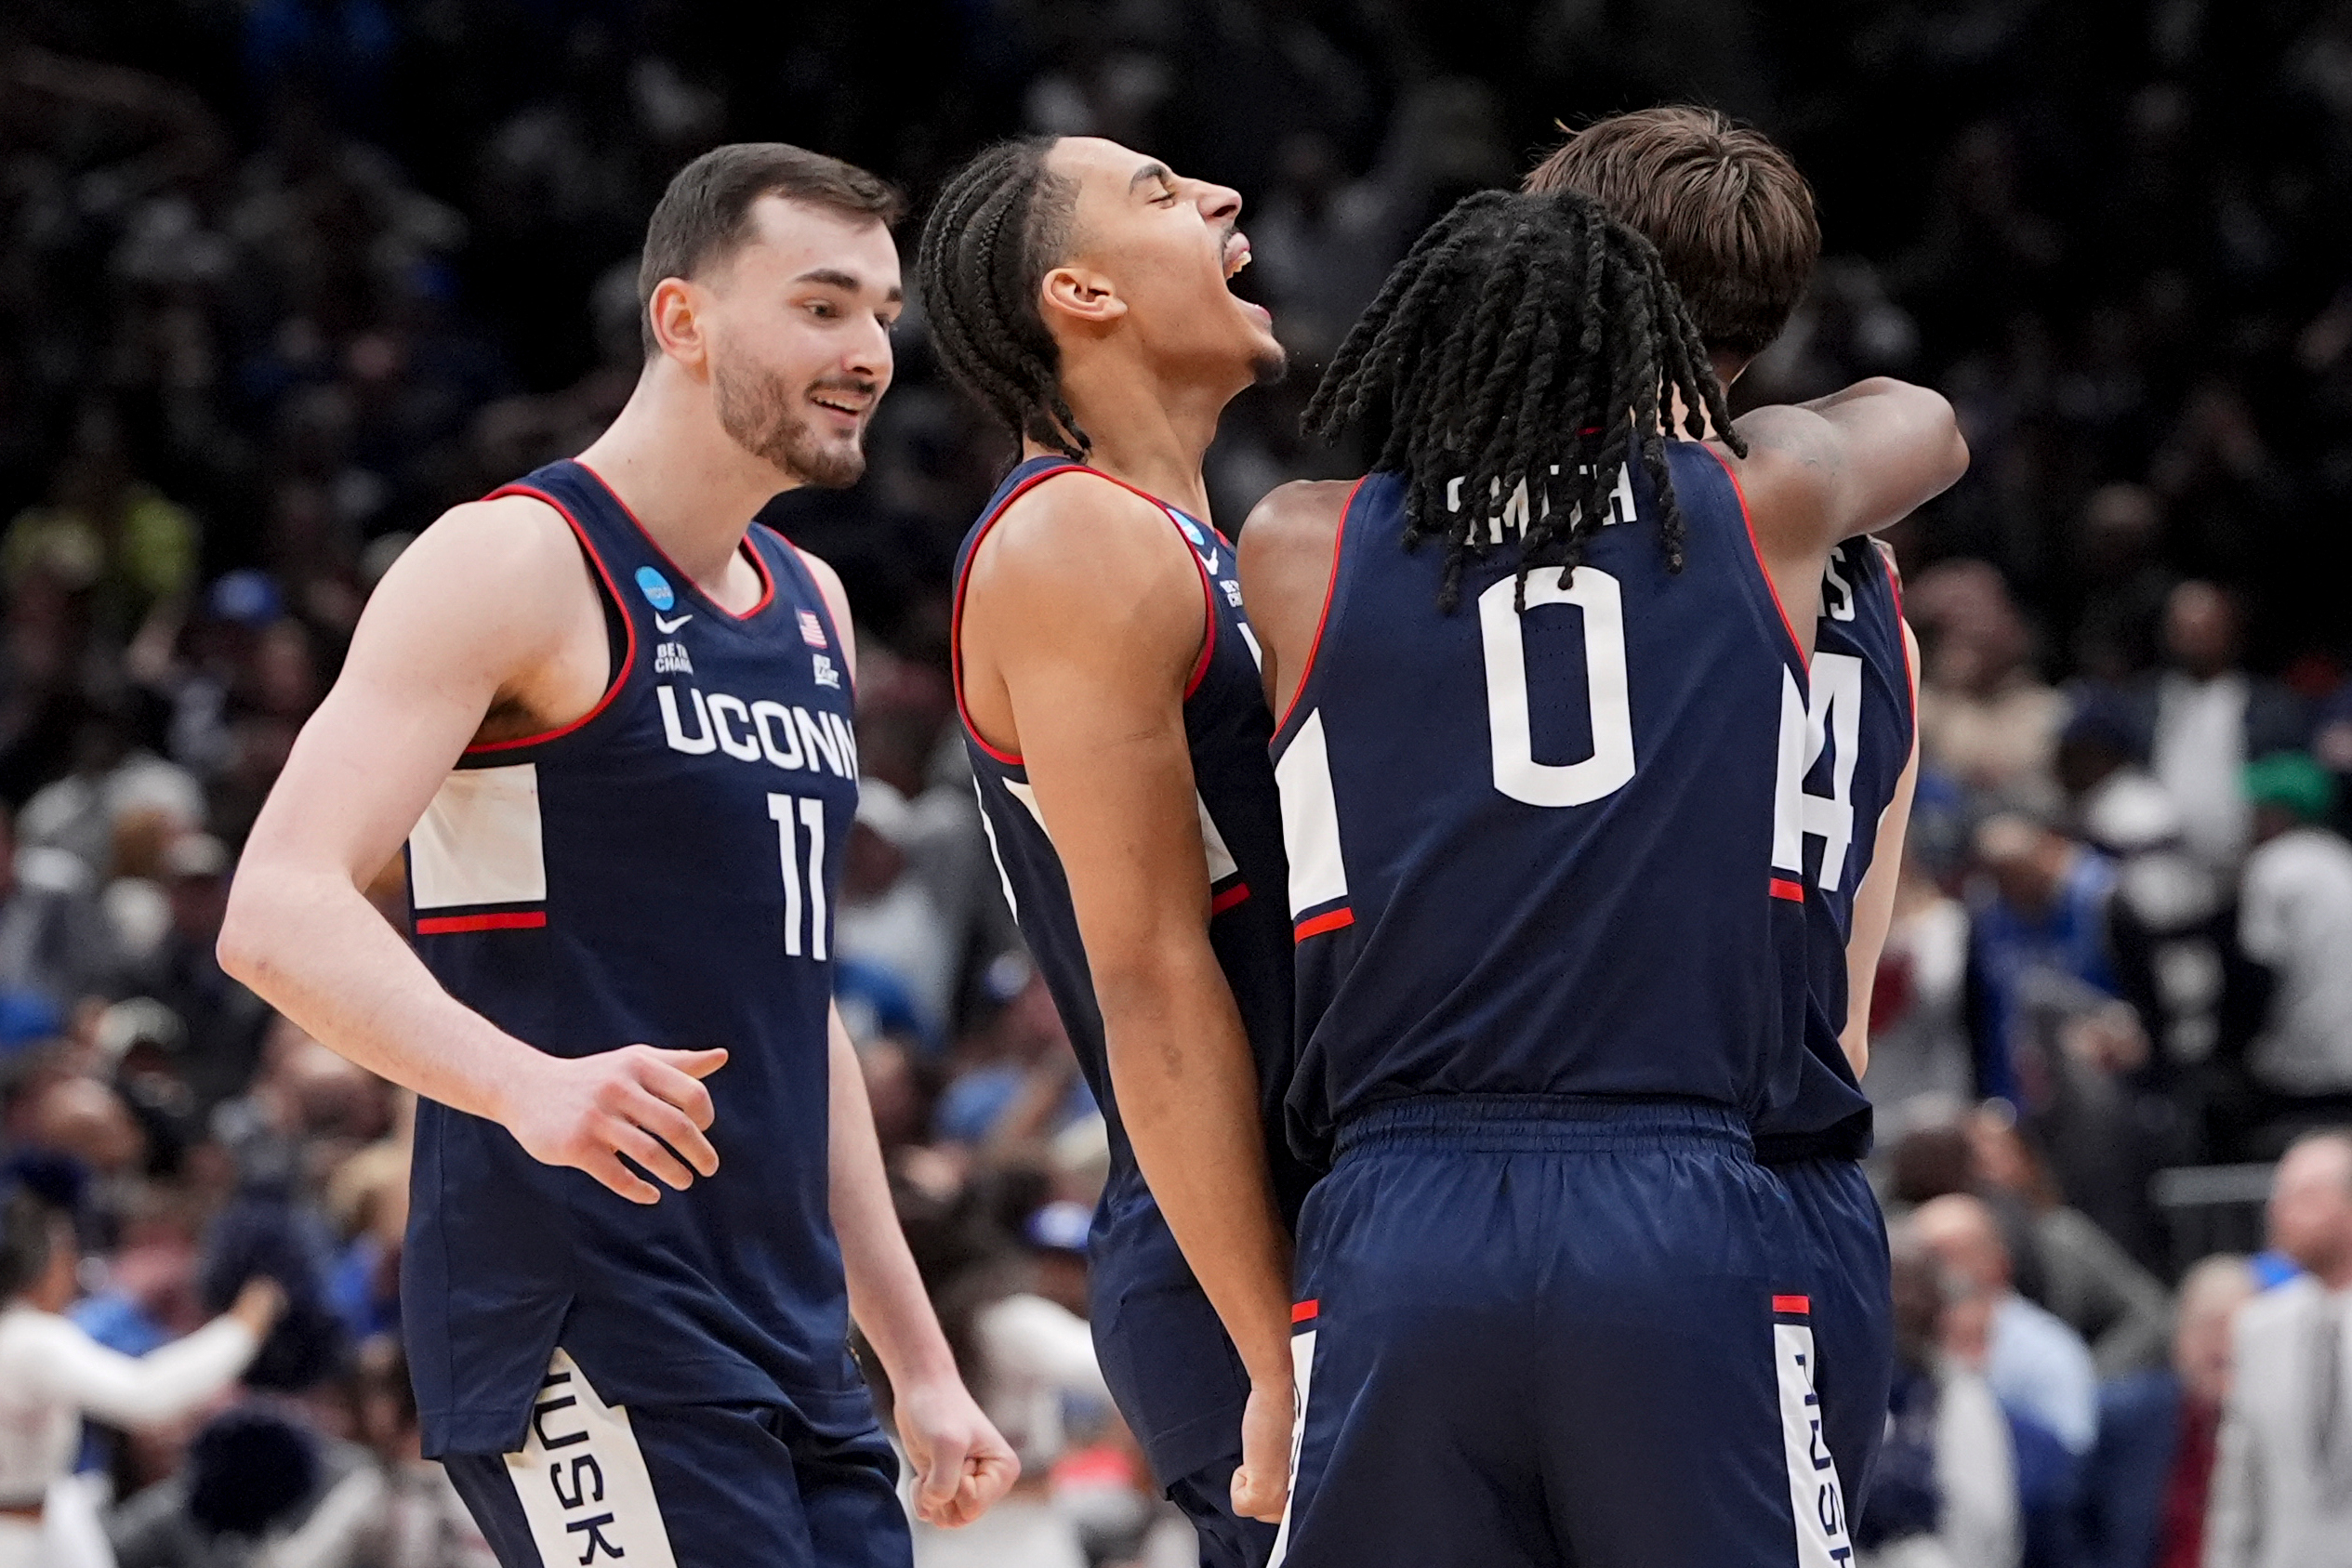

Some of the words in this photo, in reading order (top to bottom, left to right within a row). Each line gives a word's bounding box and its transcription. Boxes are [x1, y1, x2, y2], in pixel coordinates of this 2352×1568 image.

[656, 642, 676, 659] BE
[1478, 565, 1636, 808] 0
[656, 686, 859, 786] UCONN
[767, 793, 826, 961] 11
